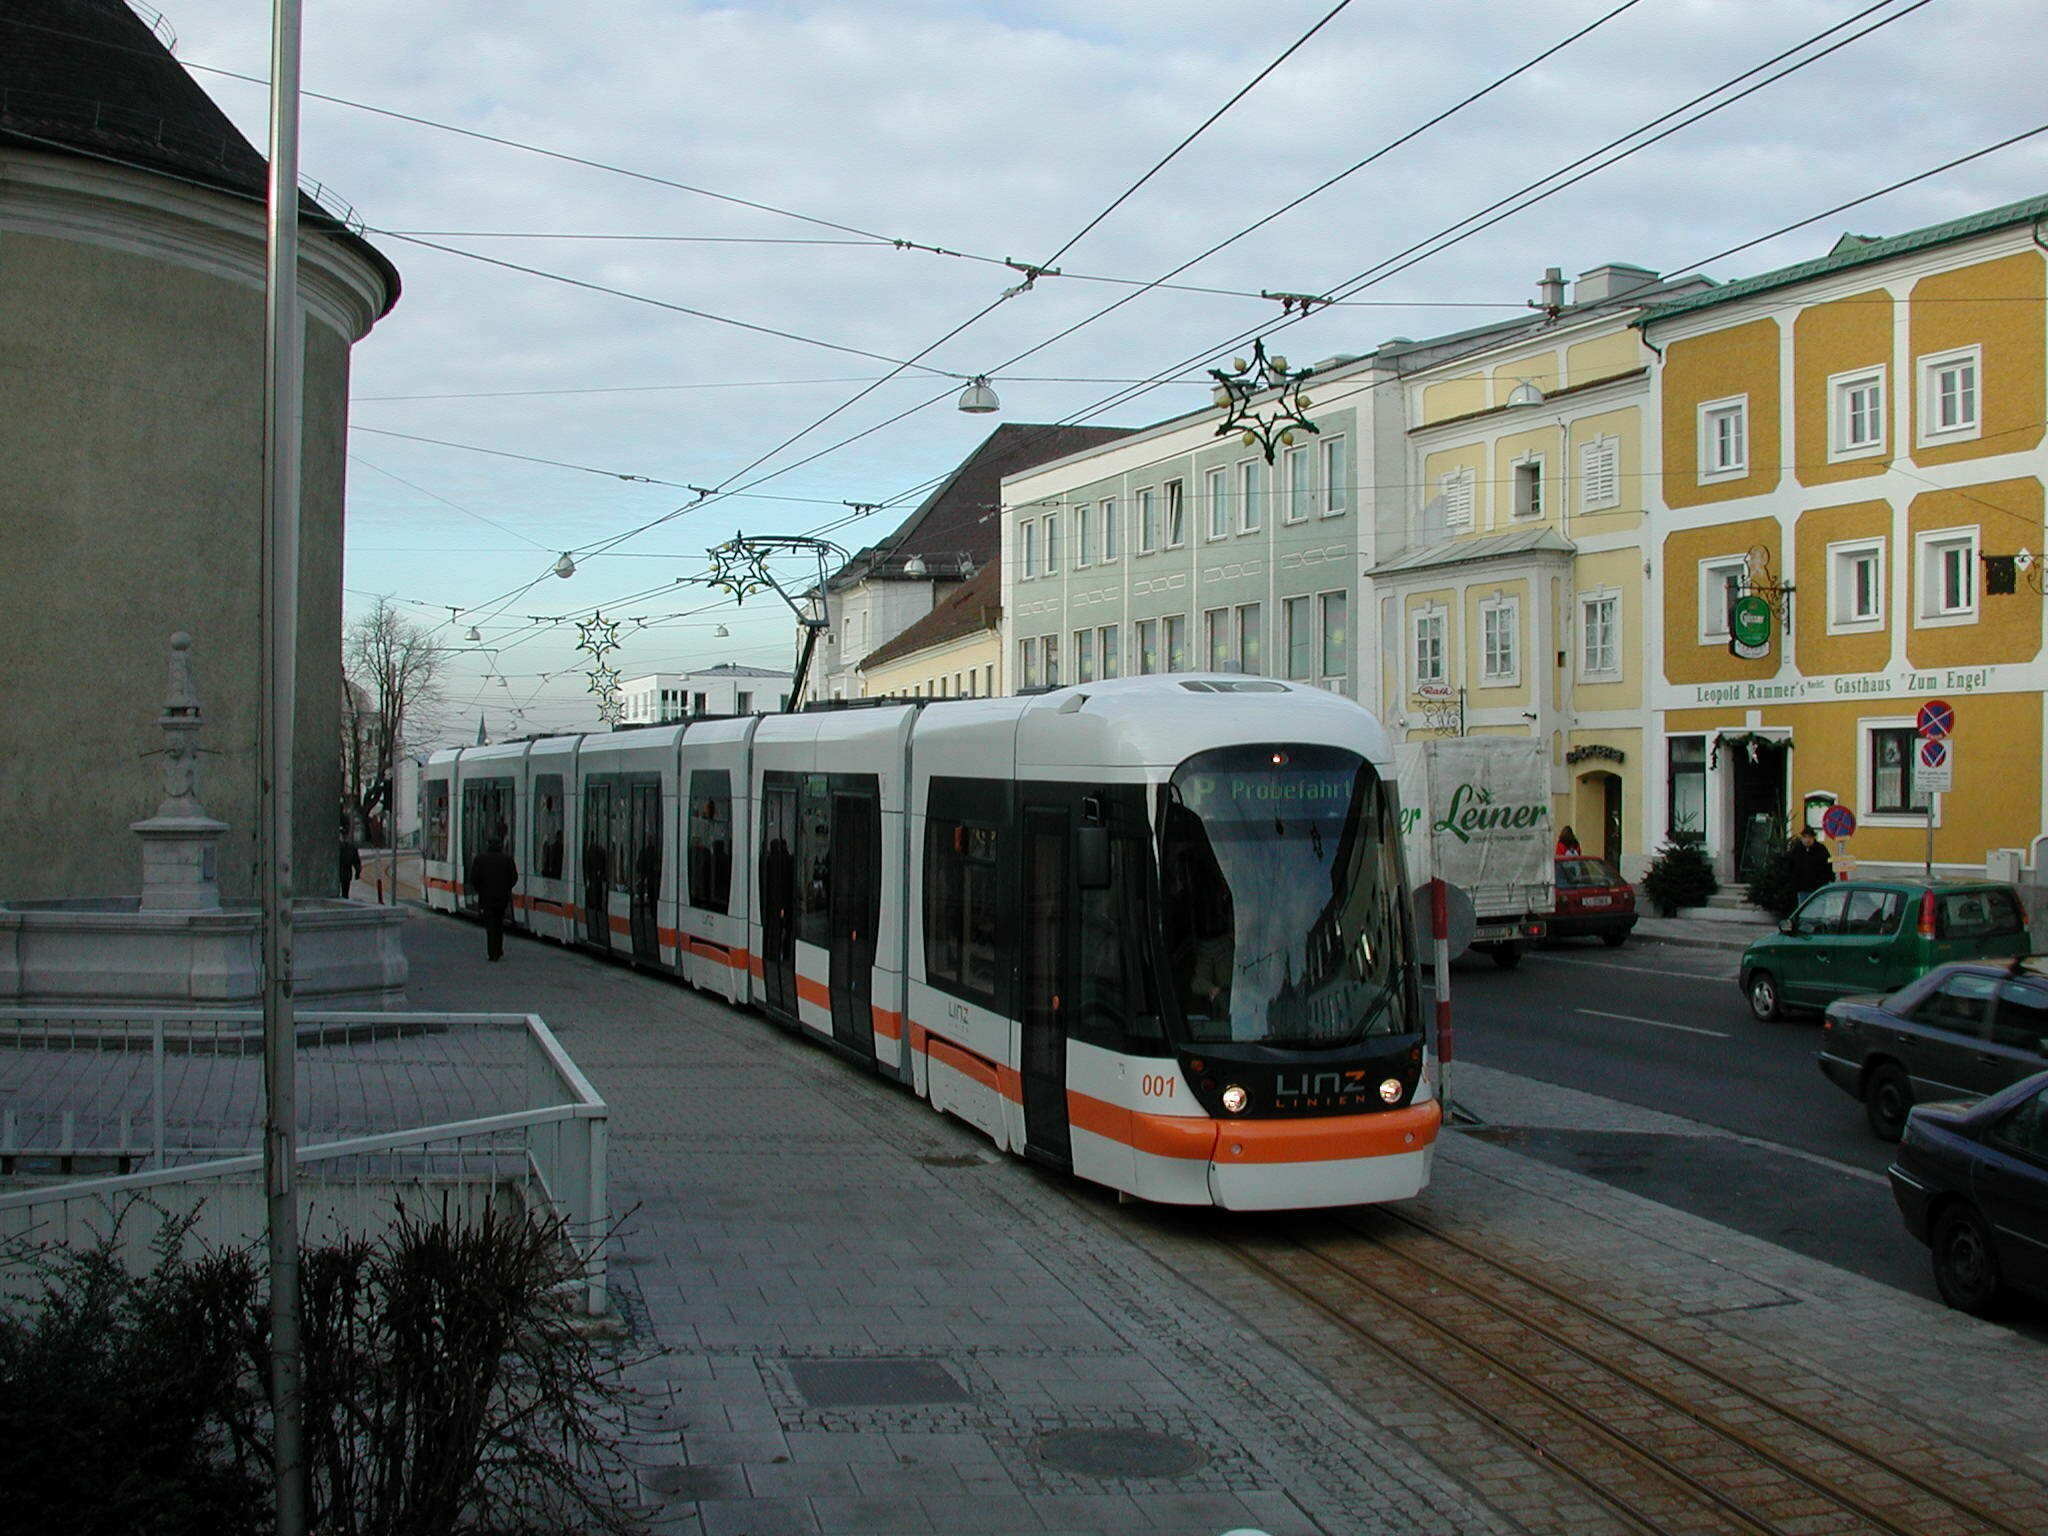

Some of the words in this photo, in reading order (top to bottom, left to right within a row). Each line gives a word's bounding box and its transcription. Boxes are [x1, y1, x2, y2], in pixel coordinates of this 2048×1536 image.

[1697, 685, 1740, 704] Leopold
[1747, 682, 1805, 699] Rammer's
[1834, 677, 1891, 694] Gasthaus
[1434, 784, 1548, 844] Leiner
[1142, 1073, 1175, 1098] 001
[1276, 1095, 1365, 1108] LINIEN
